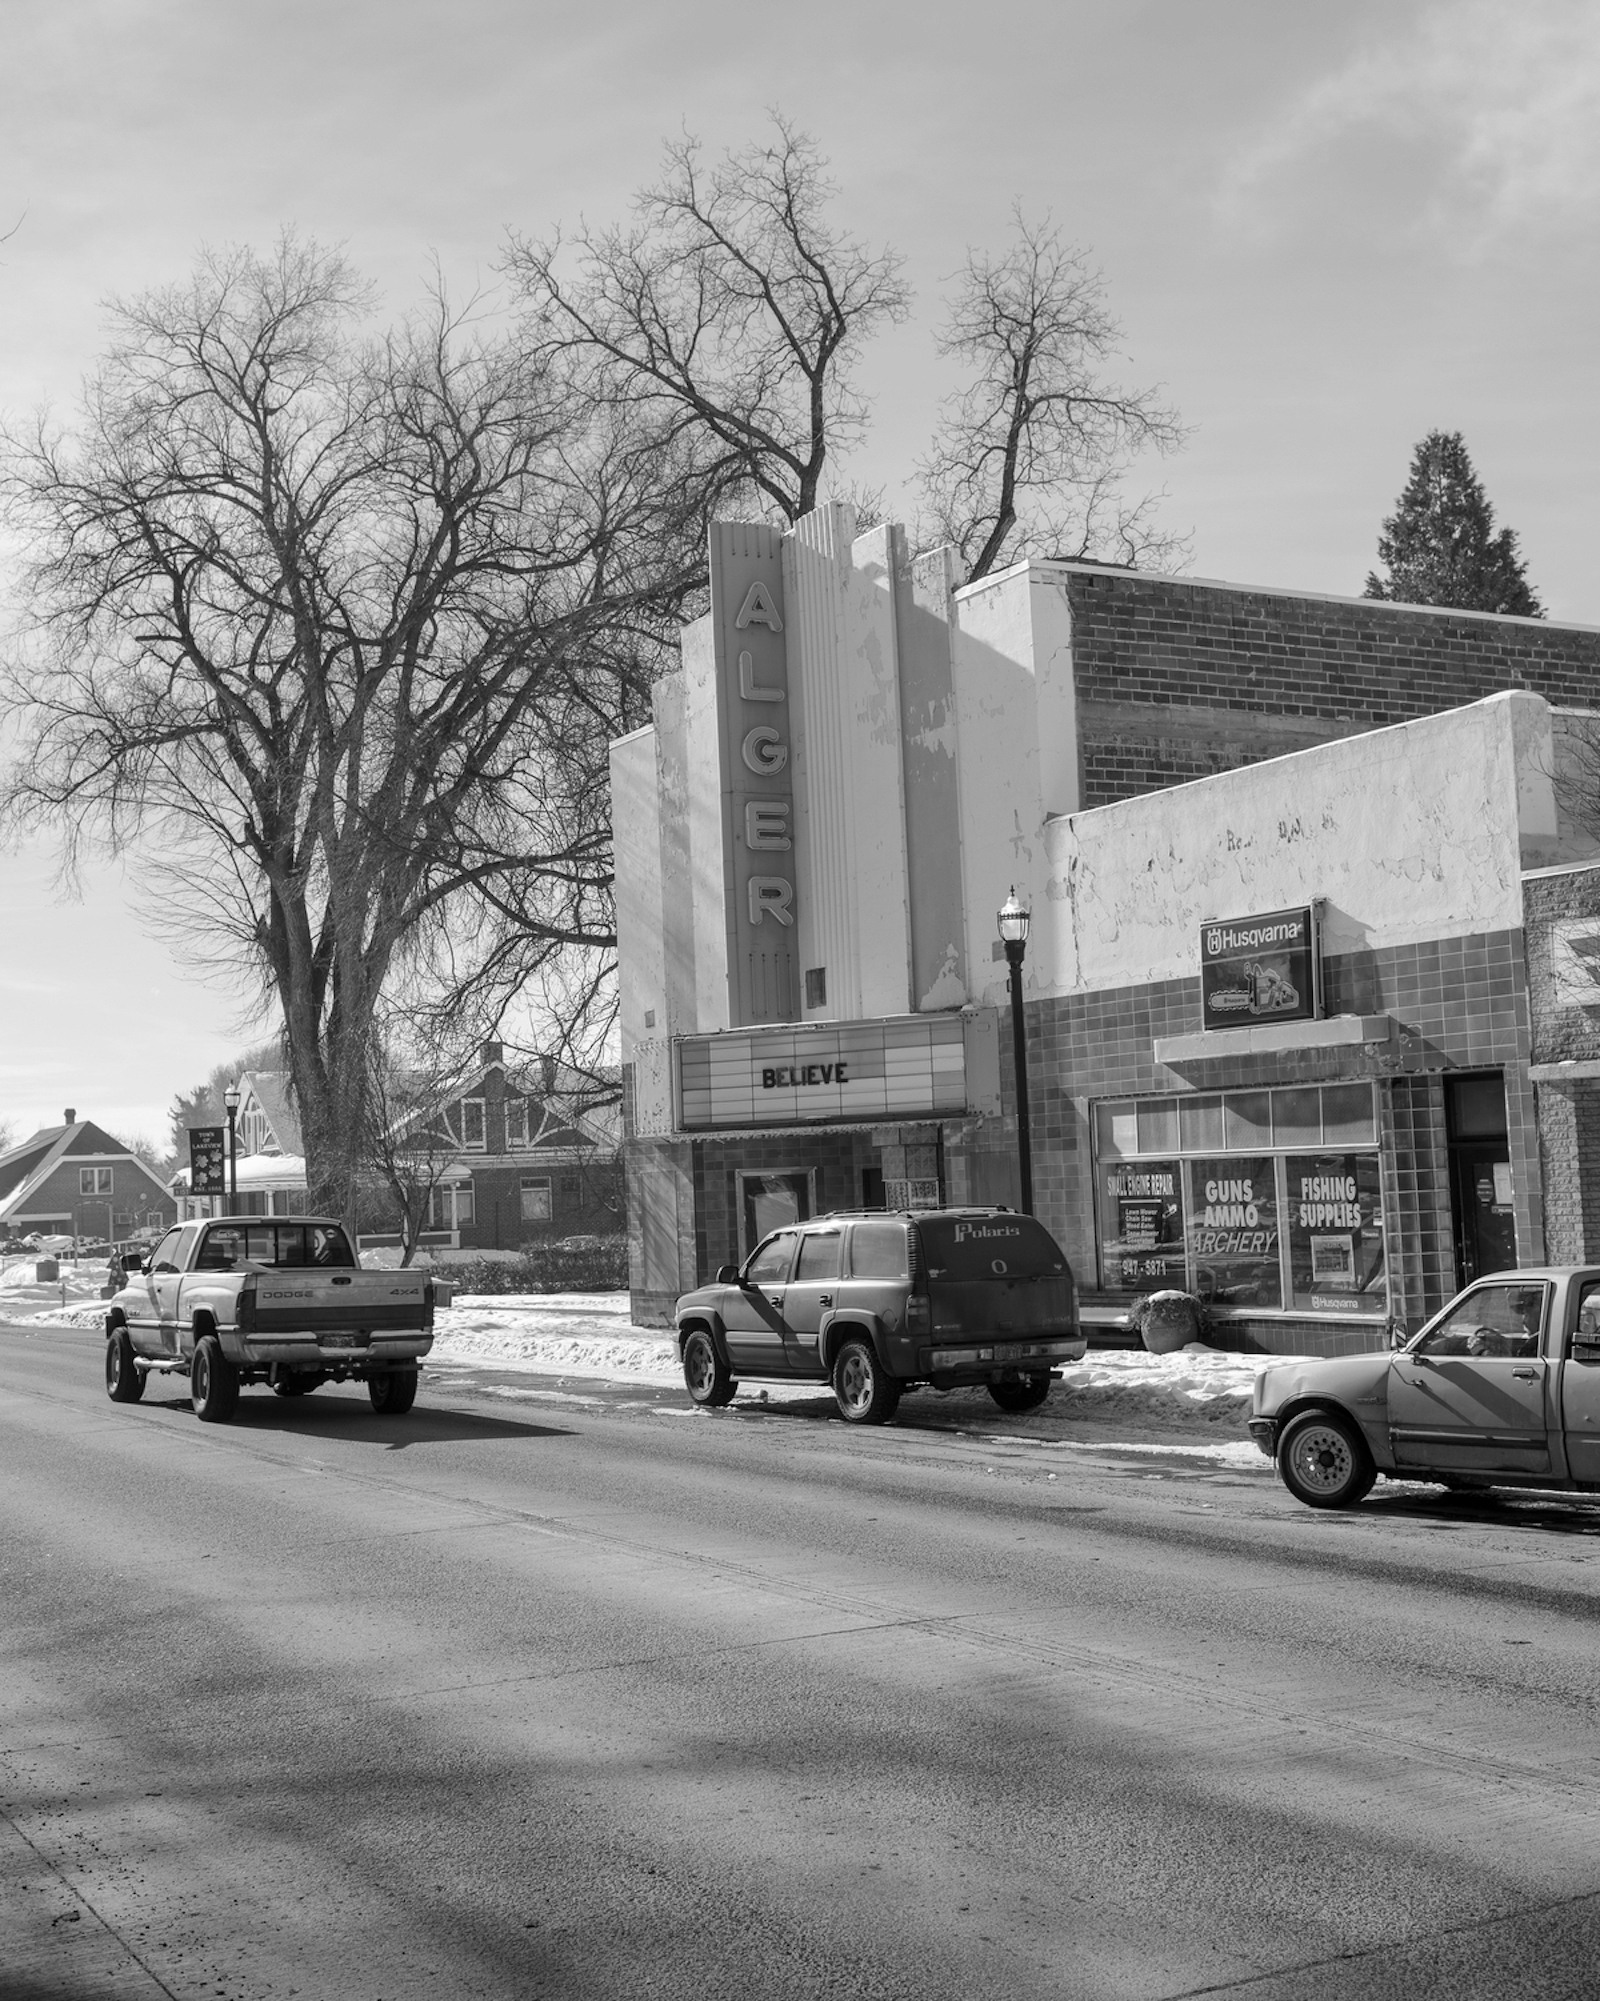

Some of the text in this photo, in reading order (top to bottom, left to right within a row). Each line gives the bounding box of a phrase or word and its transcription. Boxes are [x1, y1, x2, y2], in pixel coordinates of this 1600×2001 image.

[735, 580, 794, 928] ALGER
[1222, 923, 1298, 949] Husqvarna
[762, 1062, 849, 1089] BELIEVE
[192, 1142, 222, 1150] LAKEVIEW
[1107, 1173, 1175, 1197] SMALL ENGINE REPAIR
[1205, 1179, 1253, 1203] GUNS
[1300, 1176, 1357, 1201] FISHING
[1203, 1205, 1258, 1228] AMMO
[1299, 1203, 1361, 1228] SUPPLIES
[953, 1223, 1020, 1243] Polaris
[1192, 1231, 1278, 1253] ARCHERY
[262, 1290, 314, 1299] DODGE
[1320, 1297, 1359, 1309] Husqvarna
